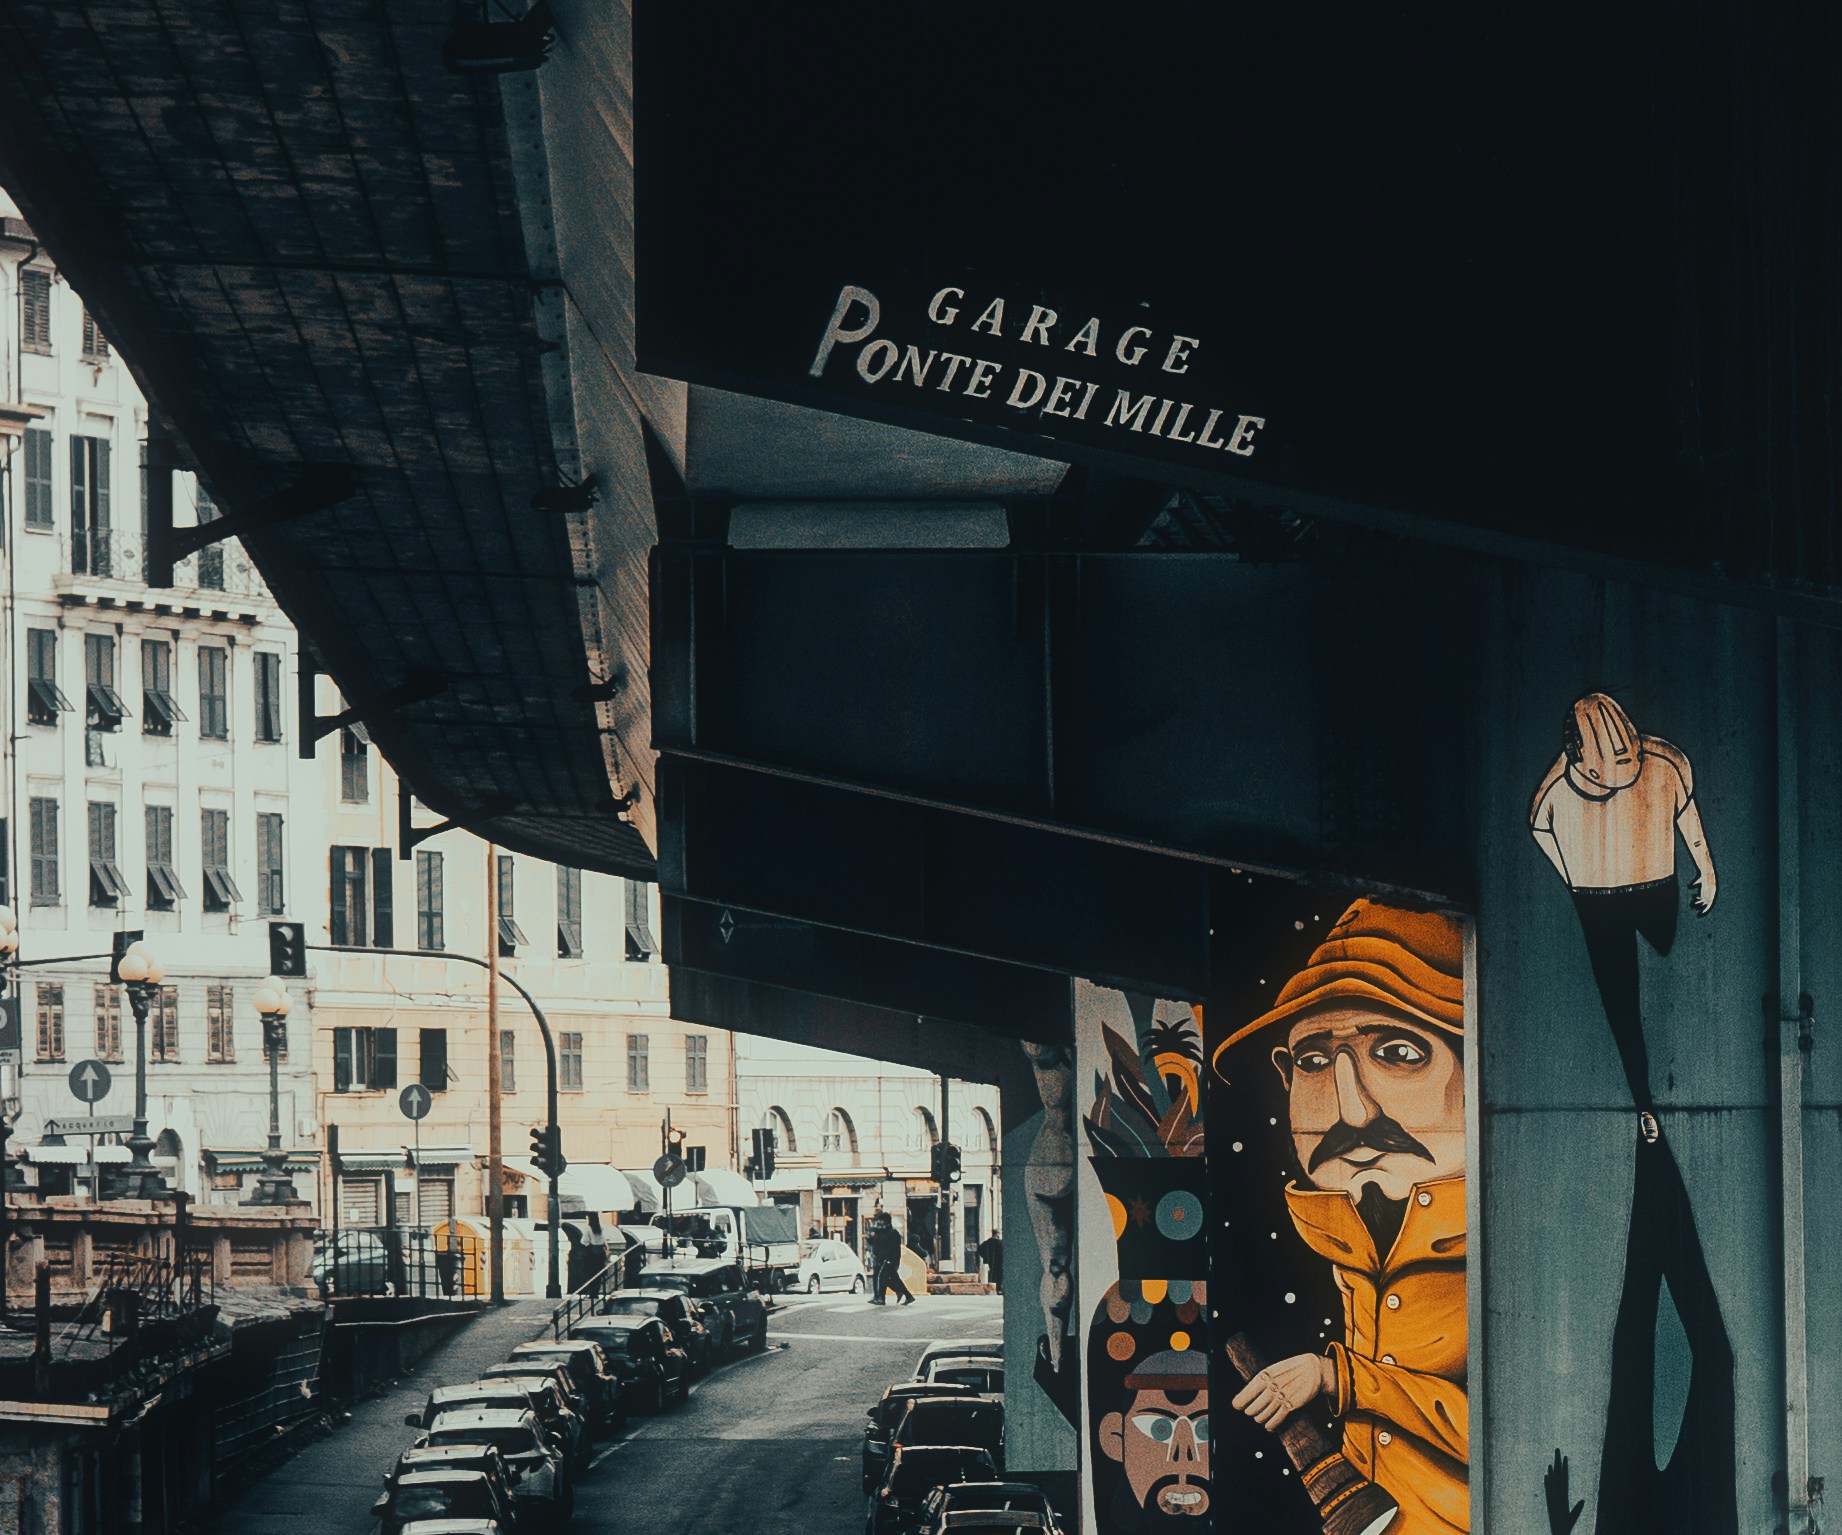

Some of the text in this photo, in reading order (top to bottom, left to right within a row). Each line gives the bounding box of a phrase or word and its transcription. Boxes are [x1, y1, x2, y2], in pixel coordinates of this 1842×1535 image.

[927, 286, 1200, 375] GARAGE
[1005, 367, 1101, 420] DEI
[1103, 388, 1267, 457] MILLE
